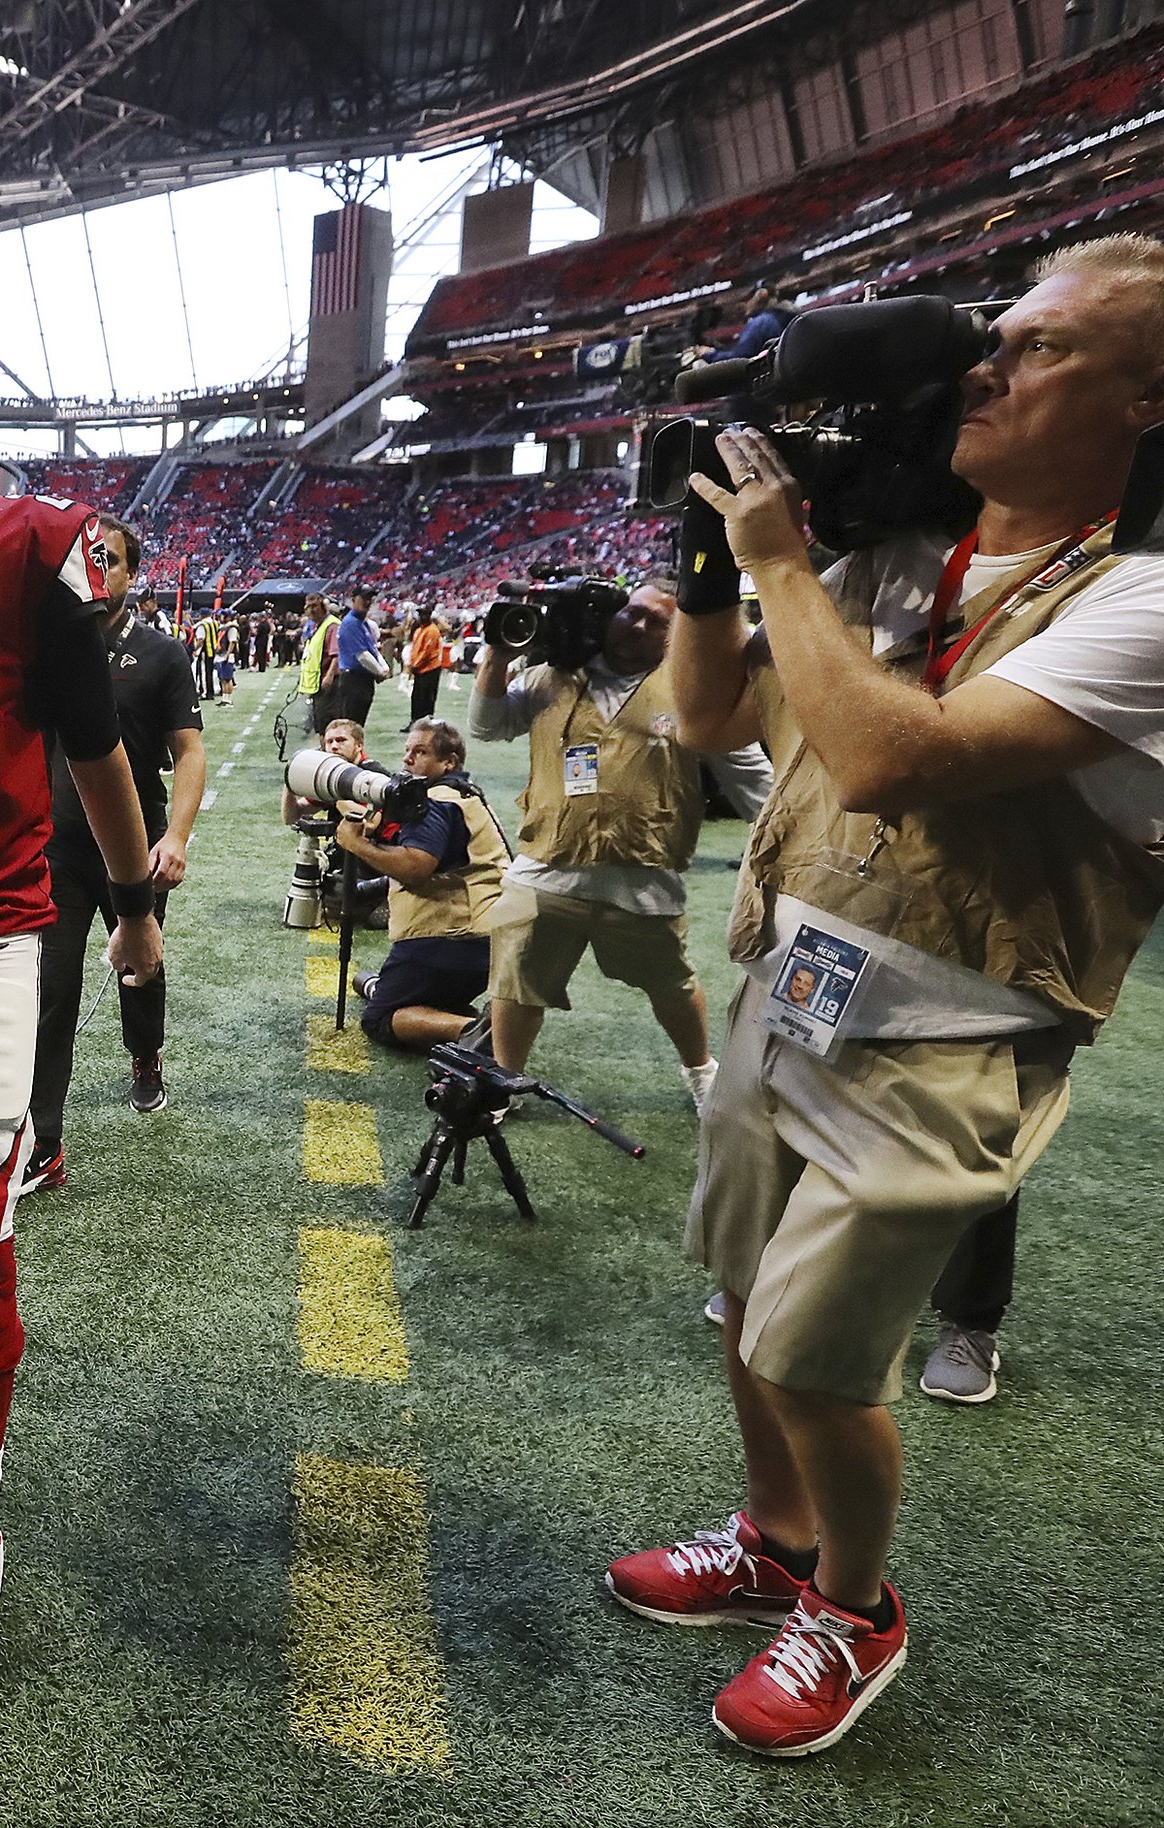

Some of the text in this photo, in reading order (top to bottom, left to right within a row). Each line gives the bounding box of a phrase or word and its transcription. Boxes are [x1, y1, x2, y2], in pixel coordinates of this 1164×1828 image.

[56, 402, 178, 418] Mercedes-Benz Stadium
[815, 945, 840, 961] MEDIA
[817, 996, 840, 1016] 19
